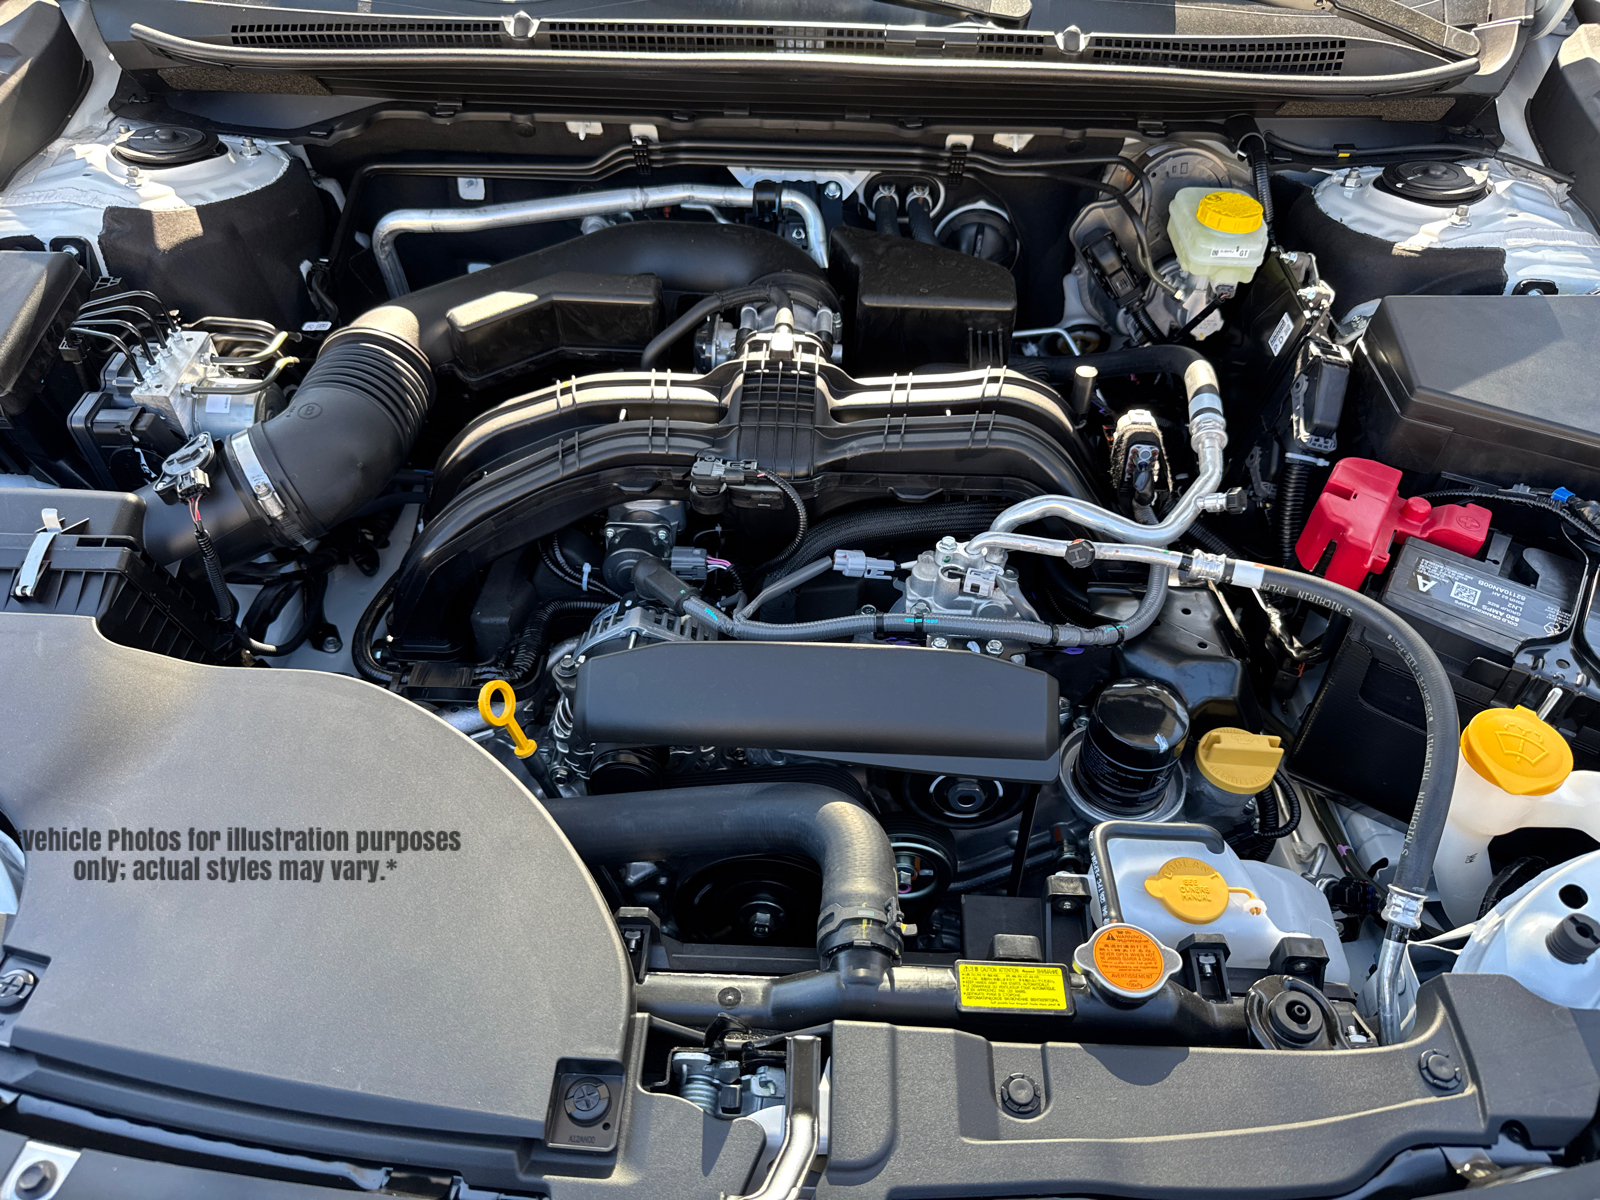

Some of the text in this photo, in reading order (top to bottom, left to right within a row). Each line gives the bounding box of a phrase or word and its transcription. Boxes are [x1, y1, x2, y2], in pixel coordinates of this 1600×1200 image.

[304, 405, 315, 416] B
[1481, 604, 1505, 617] AMPS
[1507, 602, 1523, 612] LN2
[1471, 606, 1501, 620] CRANKING
[1162, 859, 1219, 880] COOLANT
[1182, 878, 1199, 887] SEE
[1181, 893, 1212, 903] MANUAL
